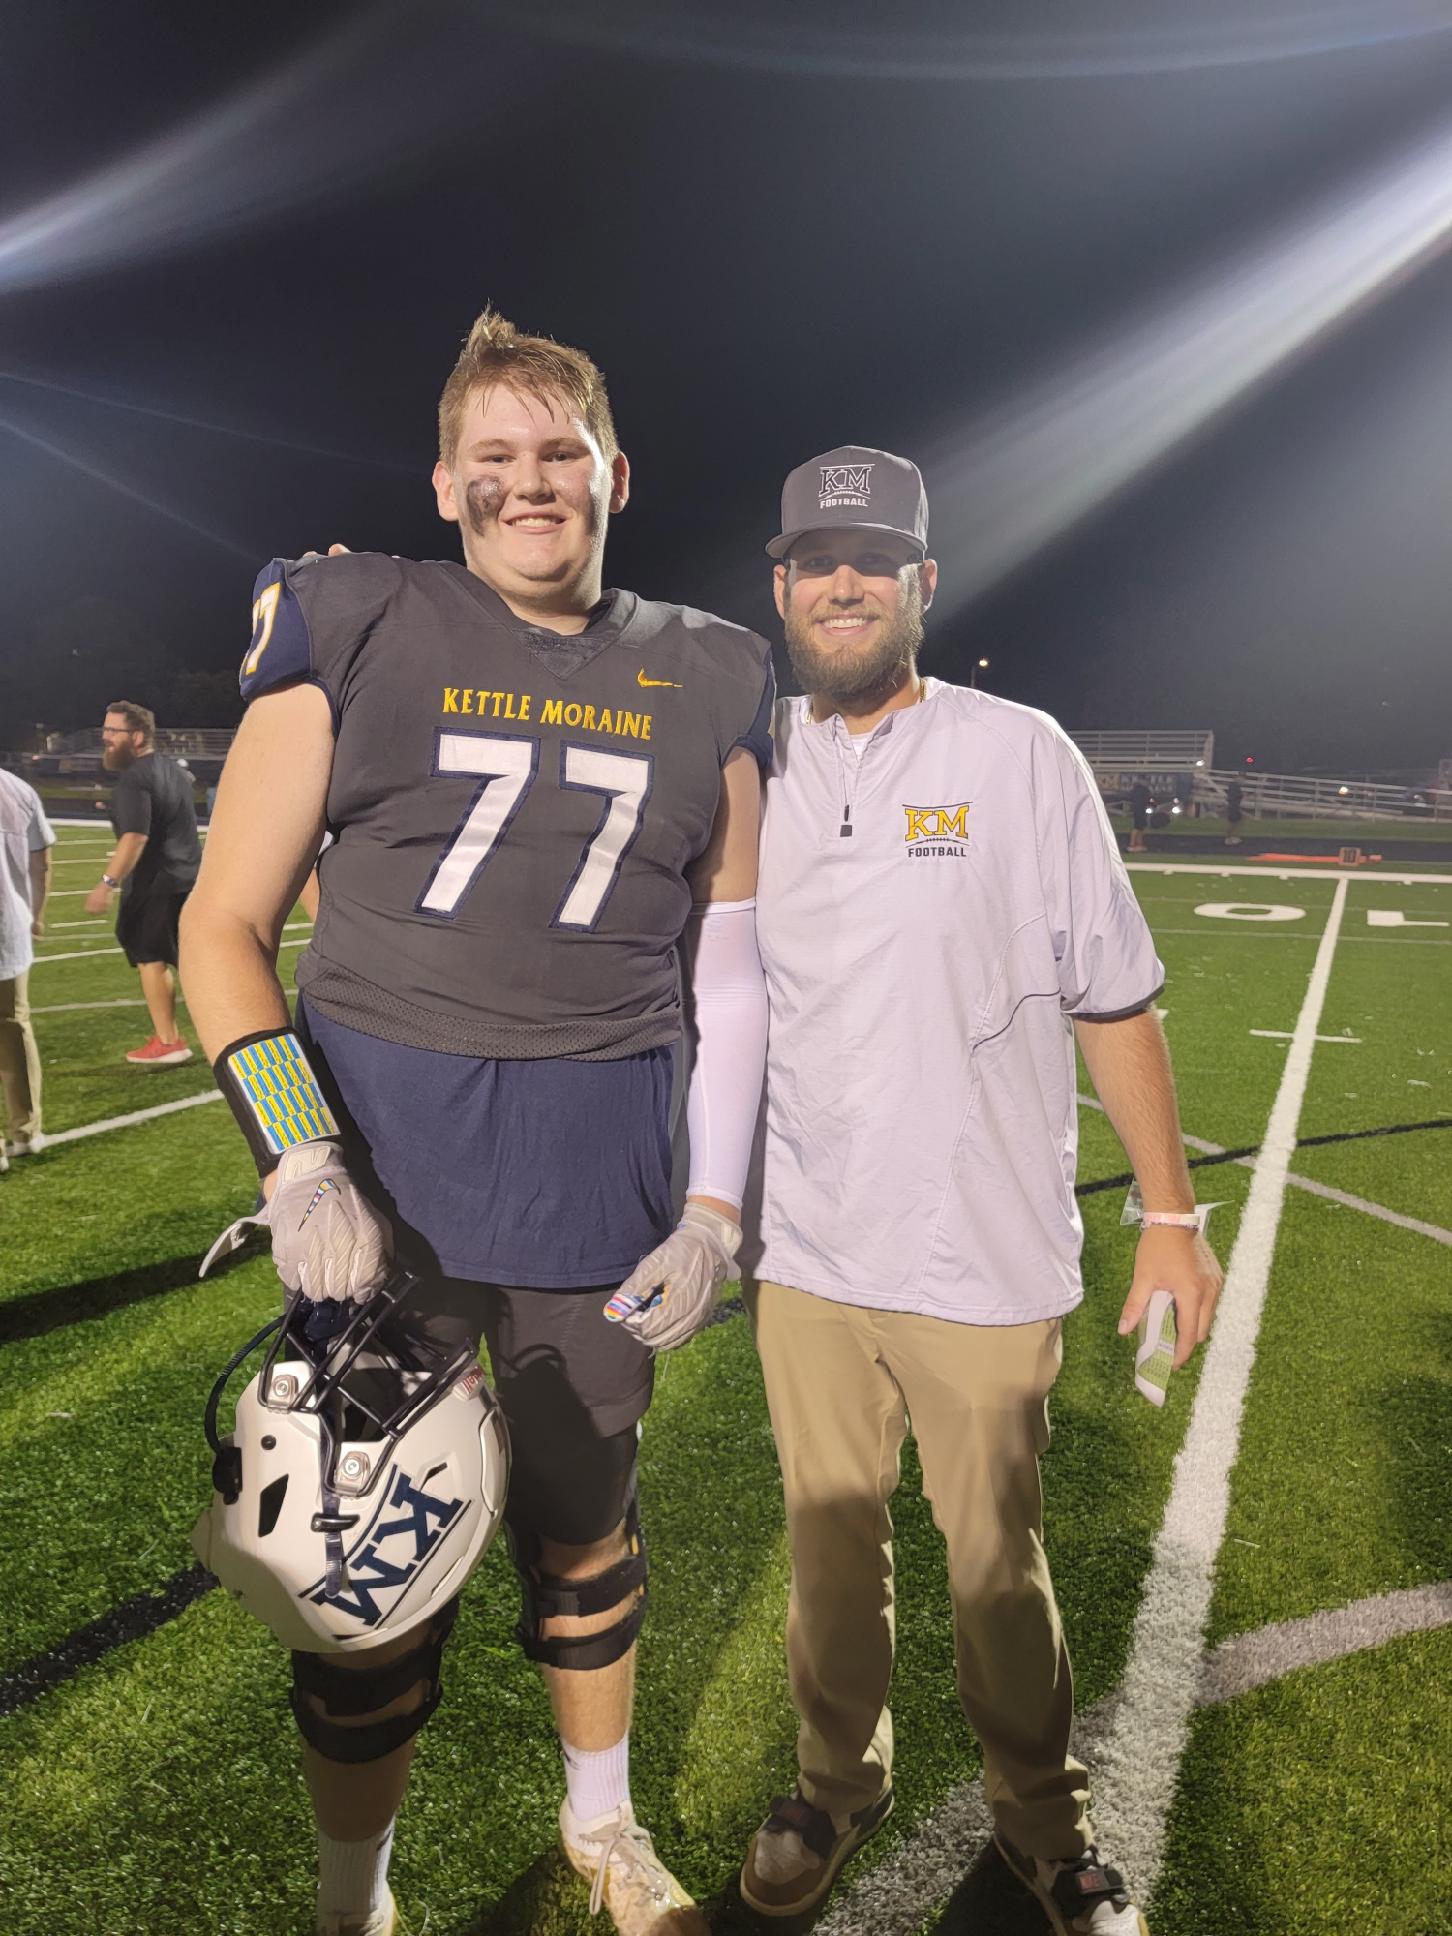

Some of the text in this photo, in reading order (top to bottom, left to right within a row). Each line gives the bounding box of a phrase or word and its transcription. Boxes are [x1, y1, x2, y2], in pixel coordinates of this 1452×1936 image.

[818, 466, 873, 497] KM
[819, 497, 869, 509] FOOTBALL
[442, 687, 653, 741] KETTLE MORAINE
[412, 726, 656, 933] 77
[904, 804, 969, 841] KM
[908, 846, 967, 858] FOOTBALL
[310, 1472, 464, 1627] KM
